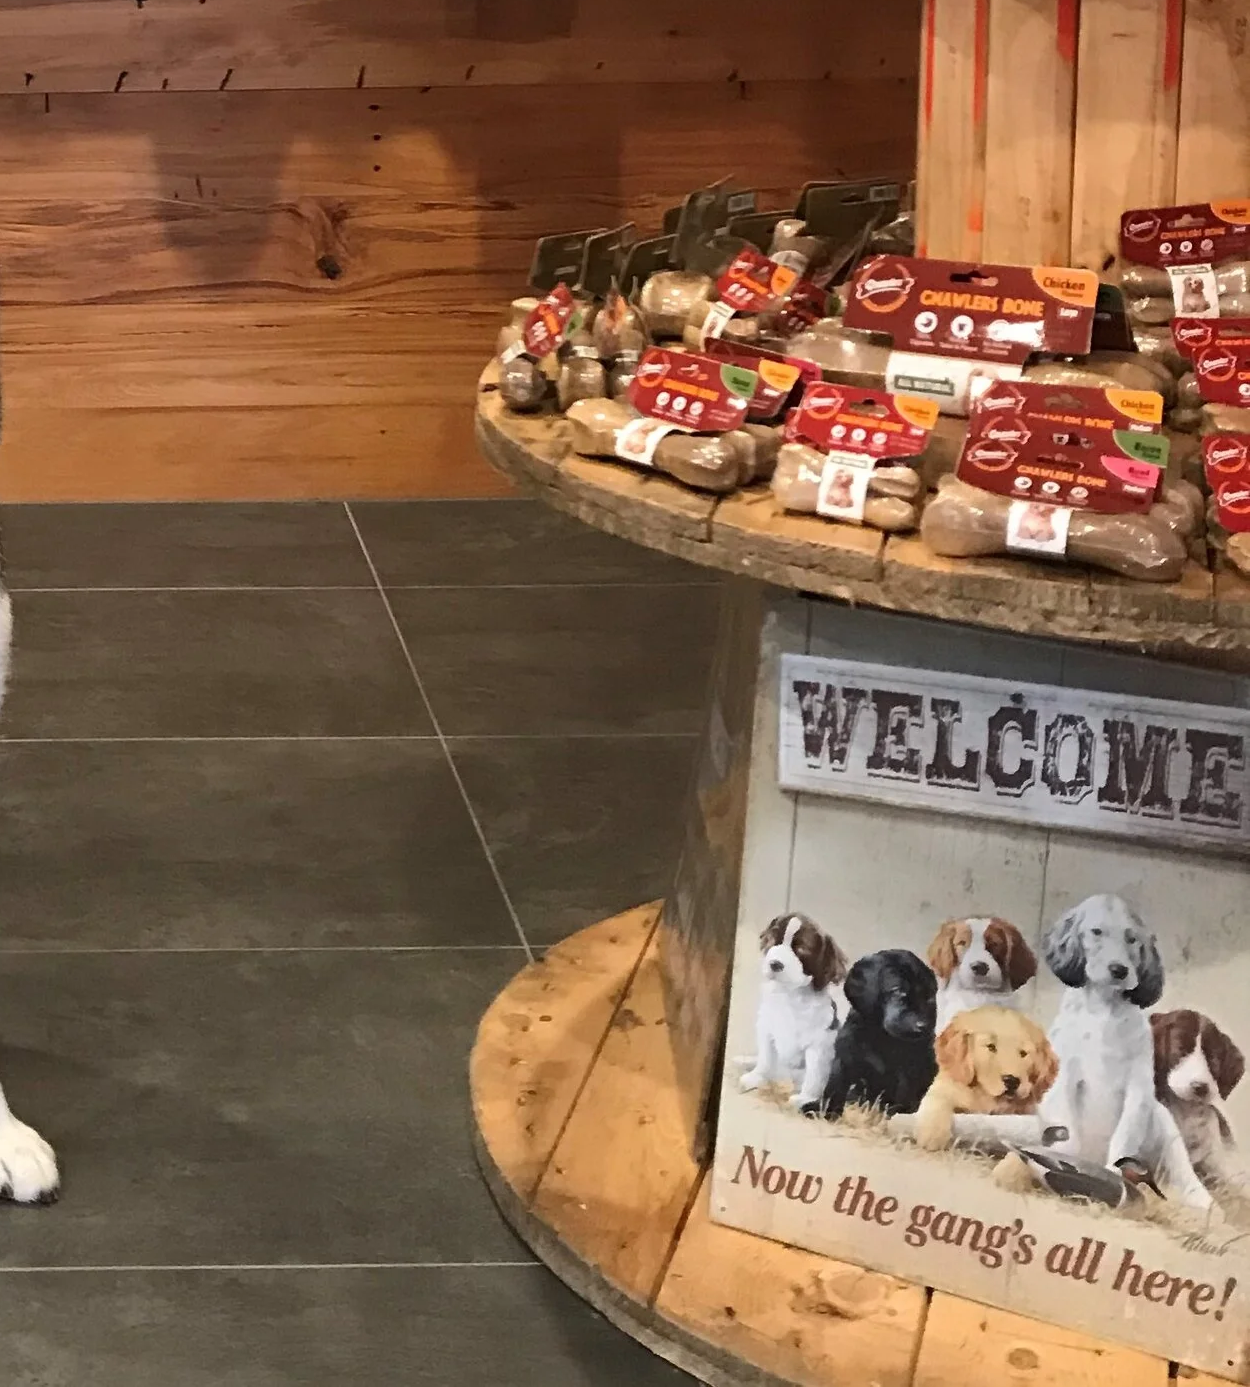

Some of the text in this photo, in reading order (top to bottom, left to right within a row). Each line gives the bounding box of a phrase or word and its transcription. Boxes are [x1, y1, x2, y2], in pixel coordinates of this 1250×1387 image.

[1002, 299, 1046, 318] BONE
[1043, 276, 1086, 291] Chicken
[792, 678, 1246, 830] WELCOME
[731, 1145, 823, 1205] Now
[833, 1175, 898, 1227] the
[1046, 1235, 1108, 1285] all
[1111, 1247, 1239, 1323] here!
